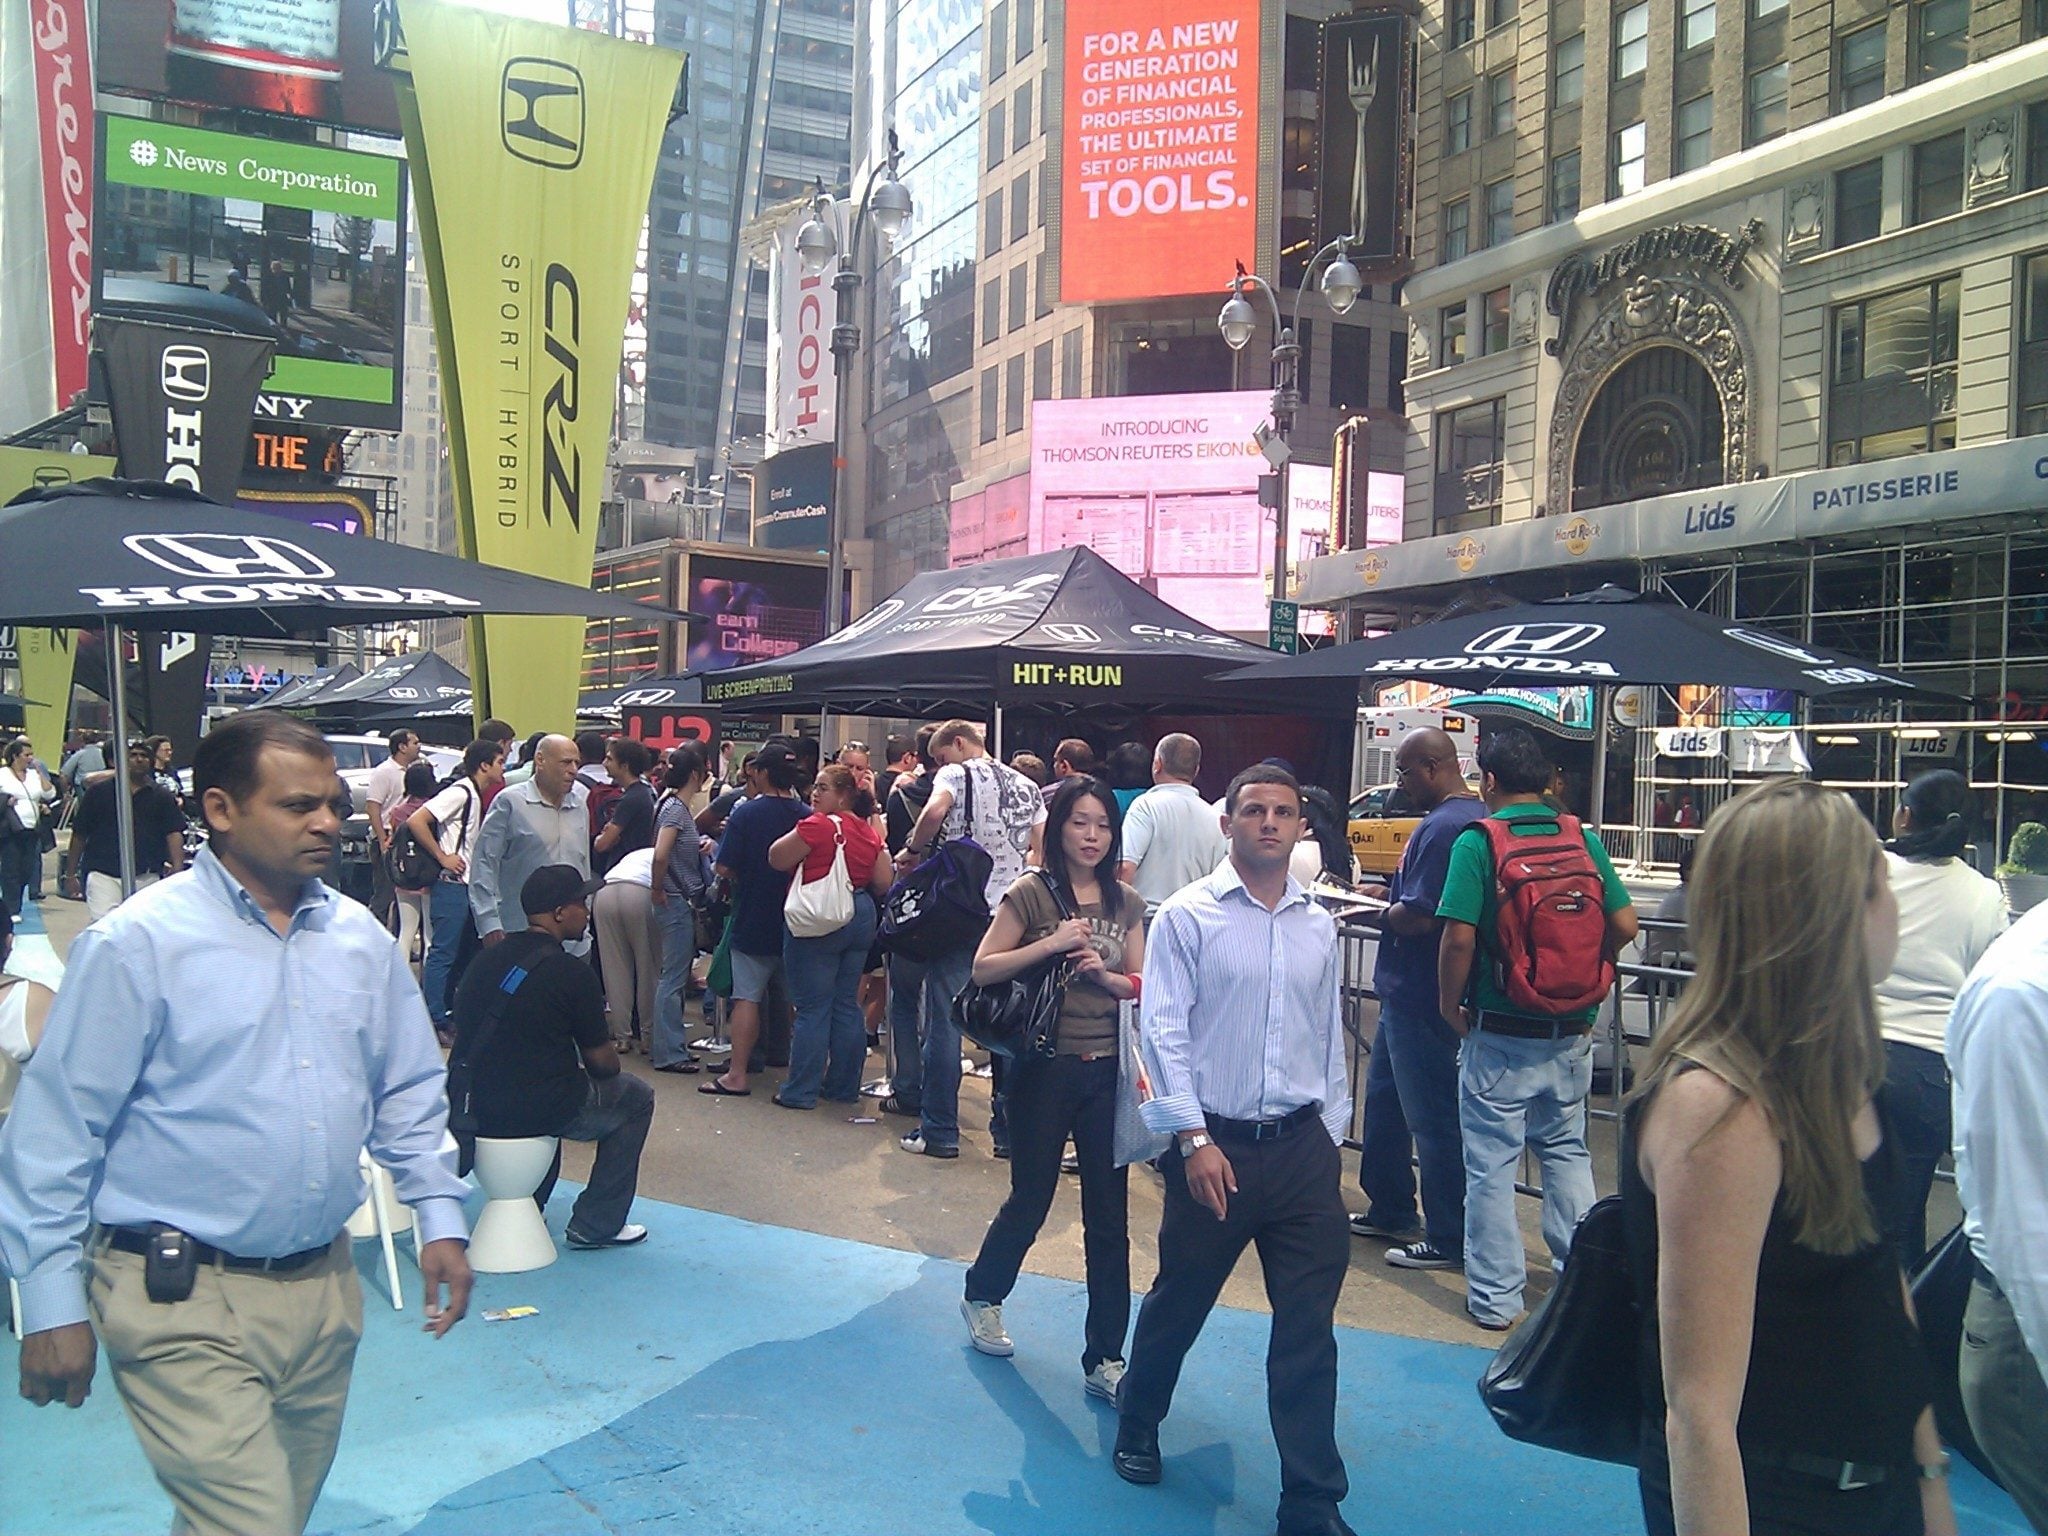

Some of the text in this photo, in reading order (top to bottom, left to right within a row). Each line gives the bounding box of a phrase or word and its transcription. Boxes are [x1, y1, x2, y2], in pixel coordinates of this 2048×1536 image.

[1083, 20, 1239, 59] FOR A NEW
[1082, 48, 1239, 83] GENERATION
[1082, 75, 1238, 108] OF FINANCIAL
[1080, 100, 1244, 130] PROFESSIONALS,
[1080, 123, 1238, 154] THE ULTIMATE
[164, 147, 378, 198] News Corporation
[1080, 148, 1238, 177] SET OF FINANCIAL
[1080, 169, 1249, 219] TOOLS.
[797, 264, 821, 426] ICOH
[498, 254, 520, 528] SPORT HYBRID
[1101, 418, 1209, 437] INTRODUCING
[253, 433, 309, 471] THE
[1042, 442, 1244, 463] THOMSON REUTERS EIKON
[1812, 470, 1960, 510] PATISSERIE
[1554, 524, 1601, 541] Hard Rock
[1684, 501, 1737, 535] Lids
[1354, 559, 1389, 572] Hard Rock
[1447, 543, 1486, 558] Hard Rock
[80, 583, 482, 609] HONDA
[1013, 664, 1122, 686] HIT+RUN
[1365, 656, 1620, 677] HONDA
[707, 674, 793, 700] LIVE SCREENPRINTING
[1669, 731, 1708, 752] Lids
